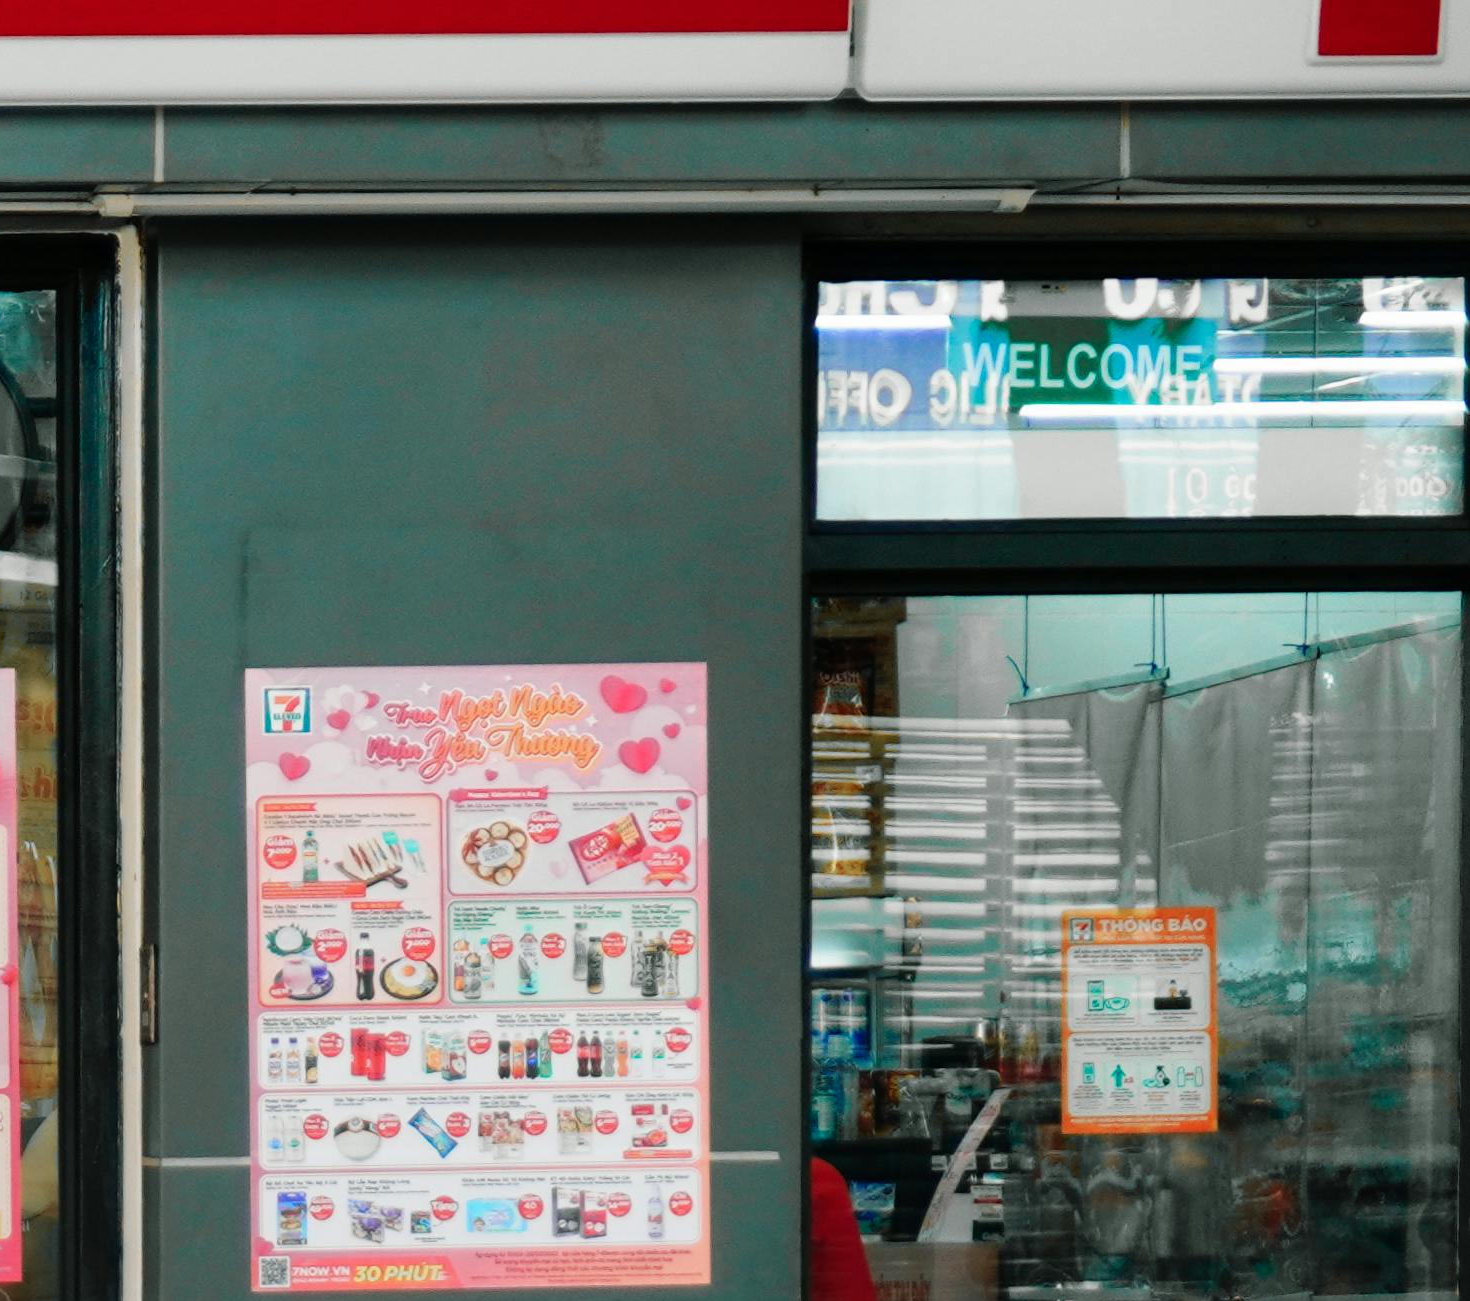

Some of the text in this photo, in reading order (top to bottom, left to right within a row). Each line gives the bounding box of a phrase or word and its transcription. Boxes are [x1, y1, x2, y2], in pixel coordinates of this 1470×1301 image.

[963, 341, 1203, 391] WELCOME
[438, 687, 506, 732] Ngọt
[510, 684, 584, 727] Ngào
[418, 726, 486, 782] Yêu
[486, 722, 601, 769] Thương
[1099, 913, 1208, 932] THÔNG BÁO
[353, 1260, 437, 1282] 30 PHÚT
